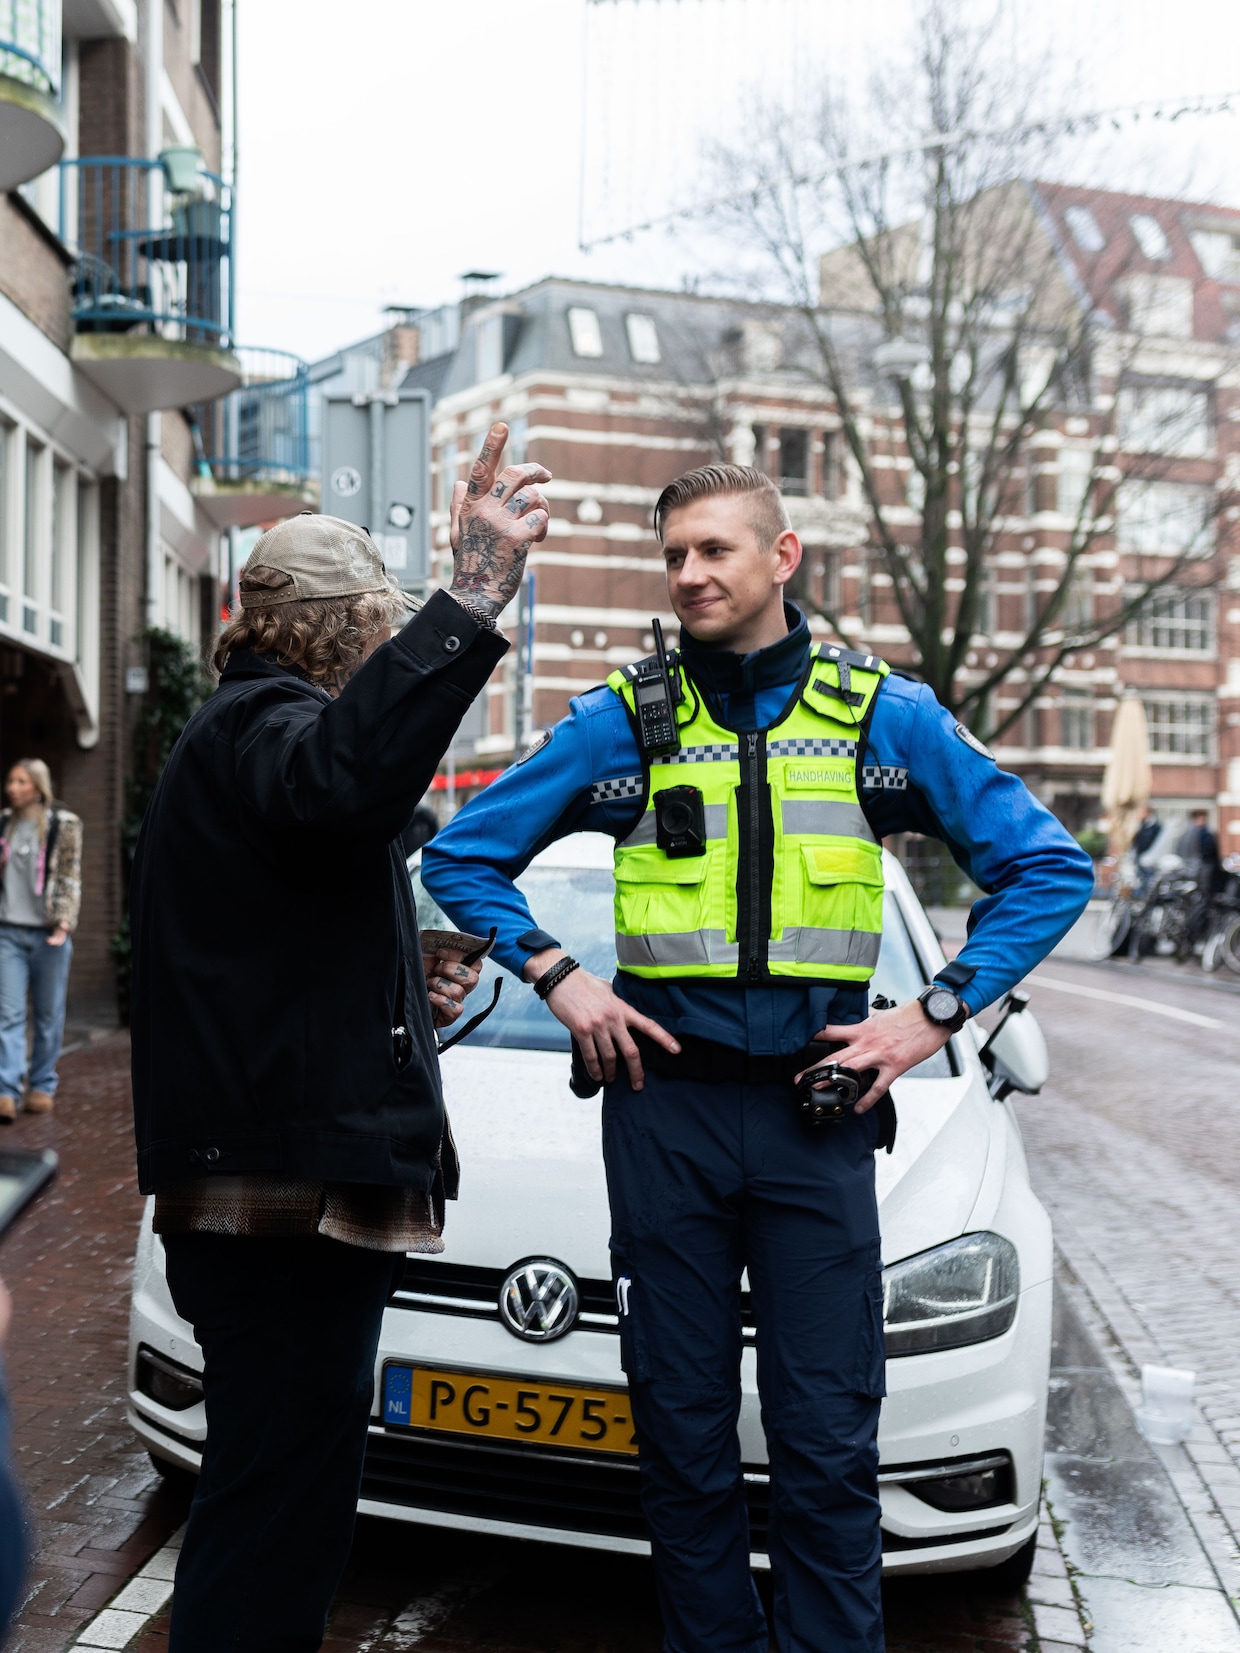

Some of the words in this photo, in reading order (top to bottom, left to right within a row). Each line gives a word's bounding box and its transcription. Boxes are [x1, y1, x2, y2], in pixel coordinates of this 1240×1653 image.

[789, 770, 852, 784] HANDHAVING
[387, 1399, 407, 1415] NL
[429, 1379, 639, 1445] PG-575-
